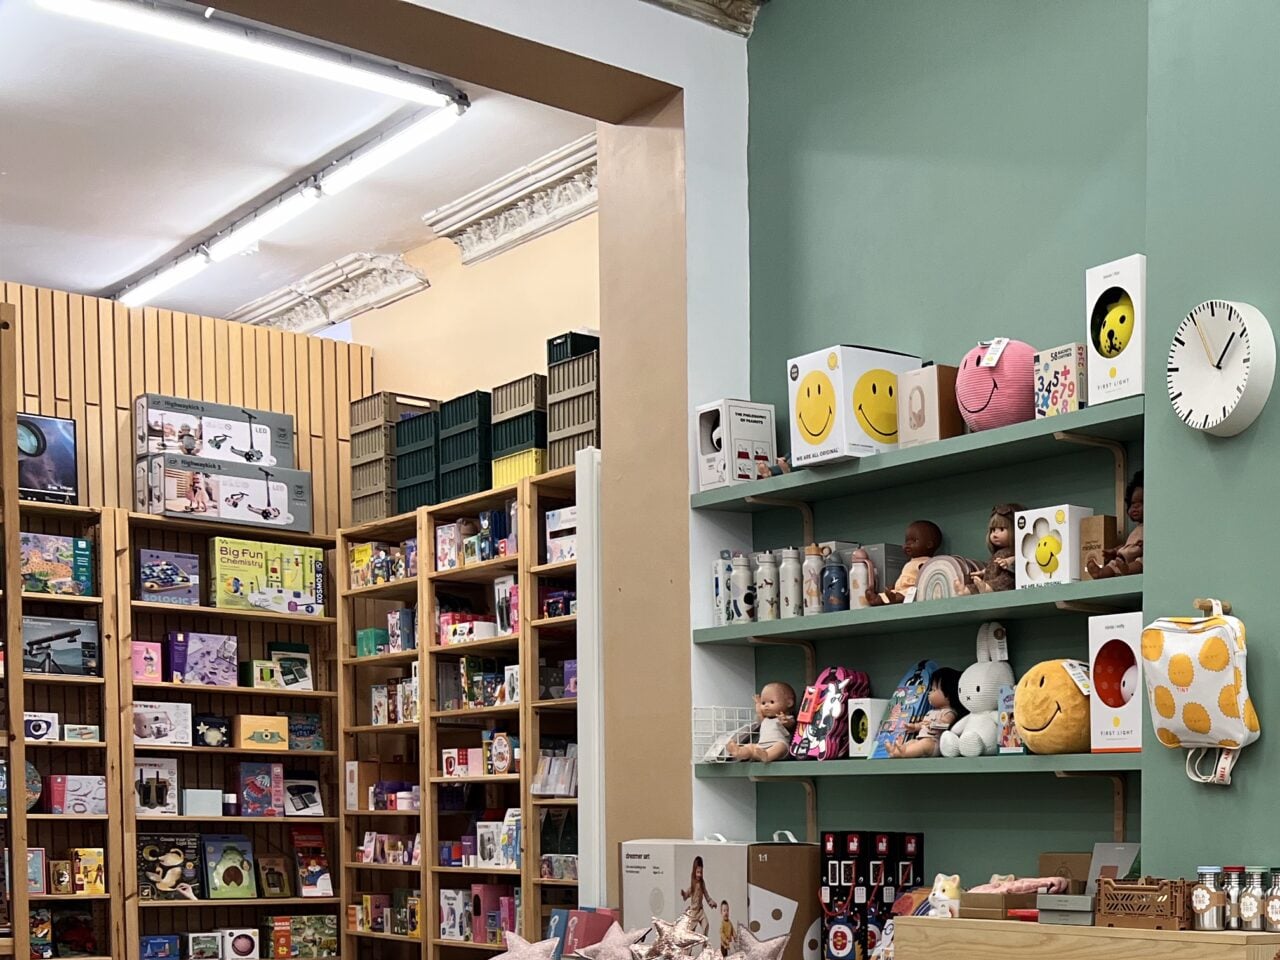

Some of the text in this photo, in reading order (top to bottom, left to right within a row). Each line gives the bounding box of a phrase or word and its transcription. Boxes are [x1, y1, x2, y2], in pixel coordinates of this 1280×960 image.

[1038, 370, 1059, 394] 3 4 5
[1098, 382, 1112, 390] FIRST
[1114, 378, 1129, 387] LIGHT
[1052, 390, 1058, 406] 6
[1060, 382, 1066, 399] 7
[1068, 381, 1074, 398] 9
[820, 448, 838, 456] ORIGINAL
[220, 546, 263, 560] Big Fun
[220, 556, 262, 568] Chemistry
[759, 854, 768, 862] 1:1
